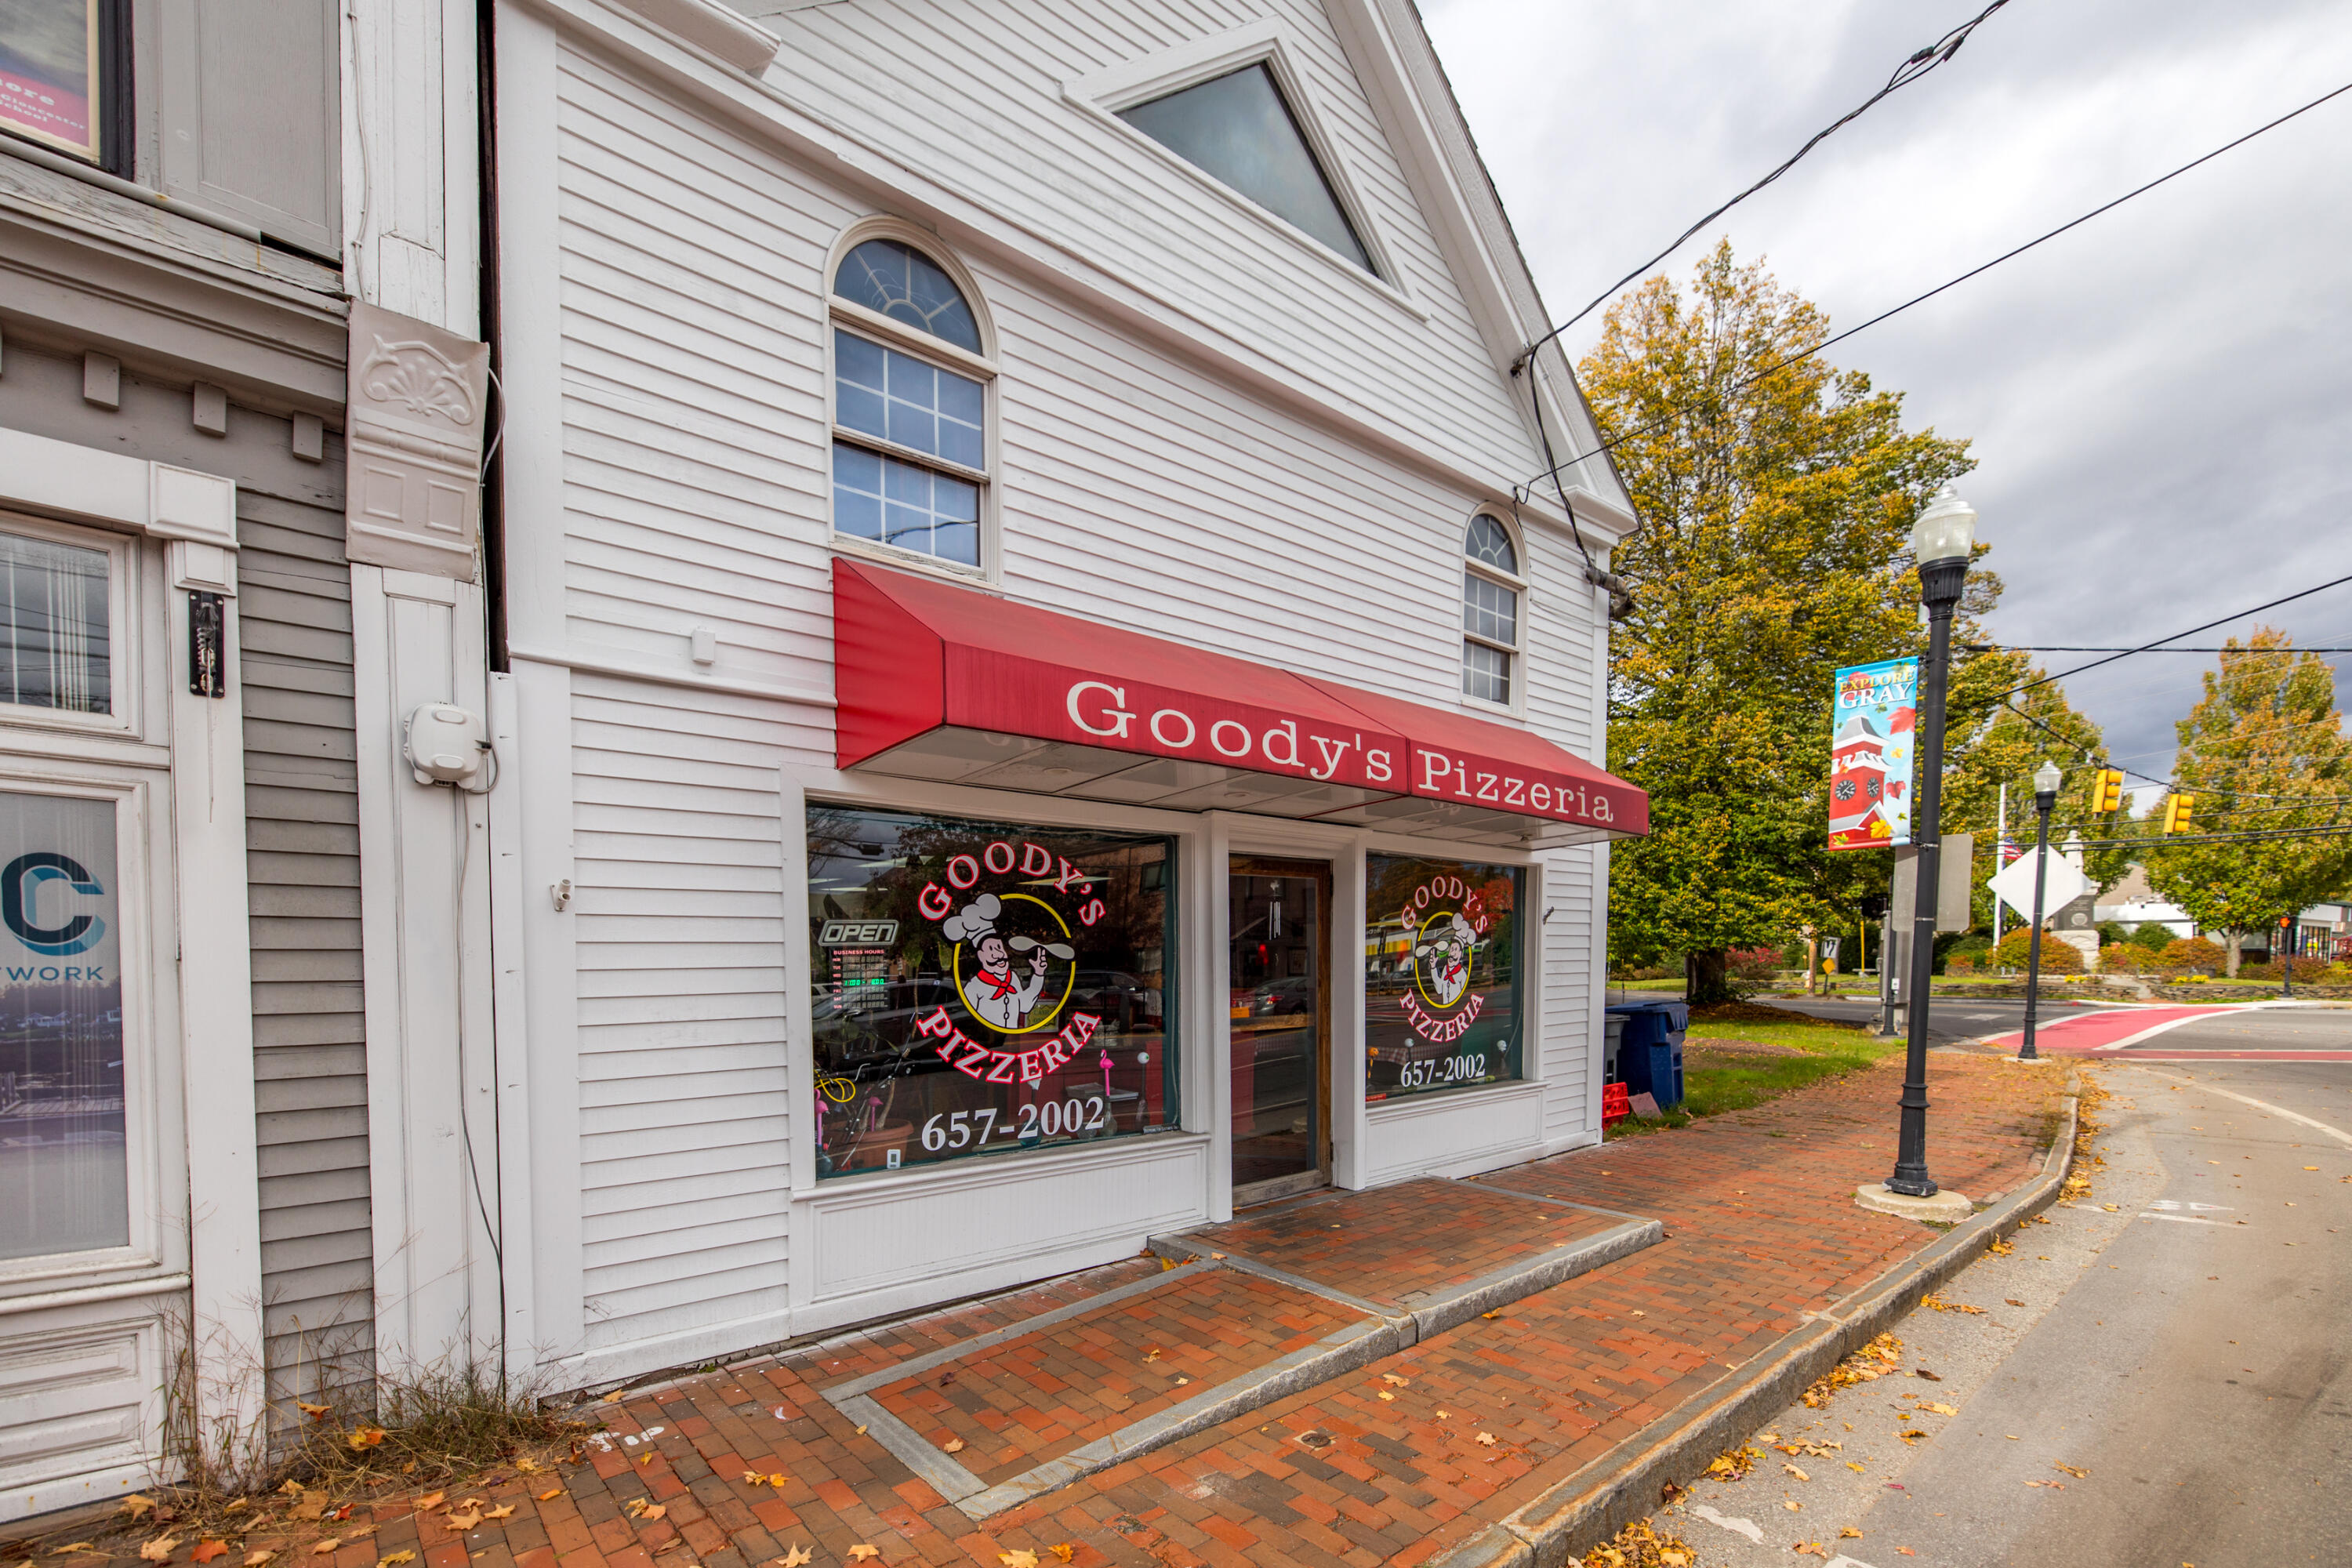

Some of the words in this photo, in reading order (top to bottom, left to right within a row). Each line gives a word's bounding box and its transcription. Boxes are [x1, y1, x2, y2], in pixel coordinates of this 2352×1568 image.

[1839, 670, 1915, 692] EXPLORE
[1839, 681, 1915, 710] GRAY
[1066, 681, 1393, 782] Goody's
[1417, 748, 1614, 823] Pizzeria
[917, 841, 1106, 927] GOODY'S
[1401, 876, 1488, 935] GOODY'S
[824, 924, 895, 942] OPEN
[0, 966, 103, 981] WORK
[1399, 987, 1485, 1043] PIZZERIA
[916, 1005, 1102, 1085] PIZZERIA
[1401, 1053, 1486, 1087] 657-2002
[922, 1096, 1105, 1152] 657-2002
